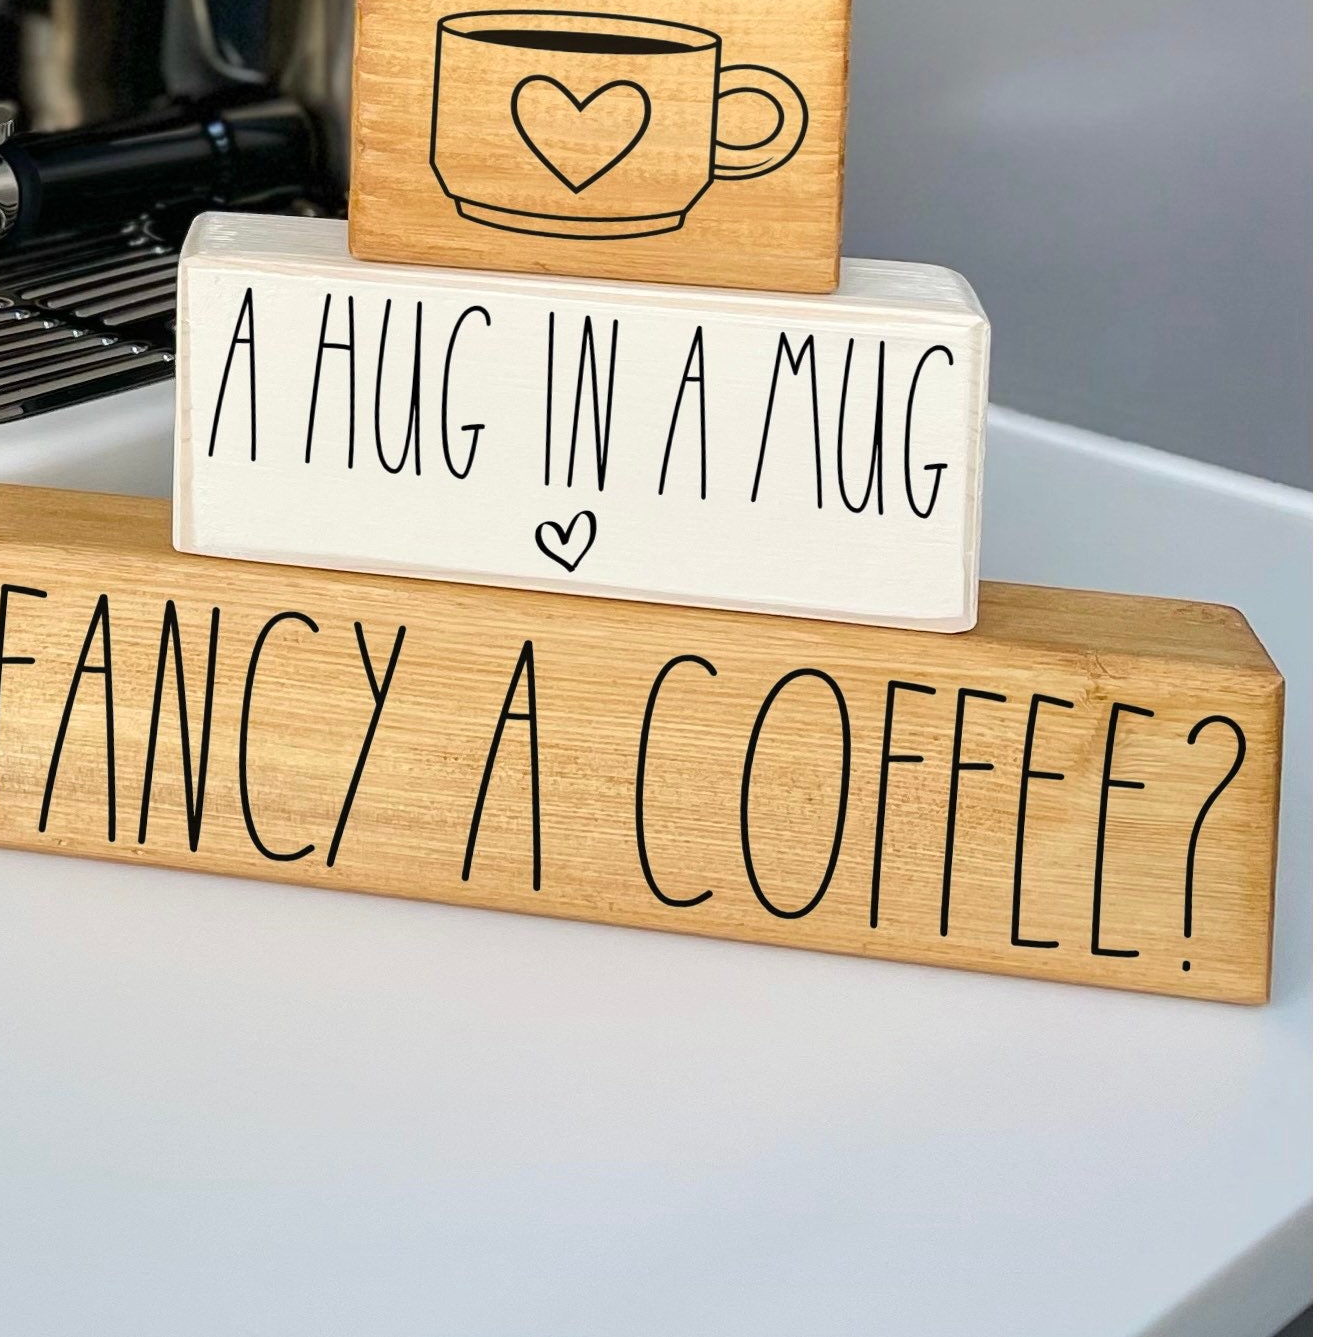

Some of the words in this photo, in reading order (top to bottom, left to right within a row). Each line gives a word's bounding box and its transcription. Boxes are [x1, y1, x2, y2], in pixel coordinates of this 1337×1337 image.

[207, 286, 258, 463] A
[304, 292, 493, 481] HUG
[543, 310, 620, 493] IN
[657, 324, 708, 501] A
[749, 330, 955, 520] MUG
[460, 639, 542, 893] A
[634, 653, 1249, 973] COFFEE?
